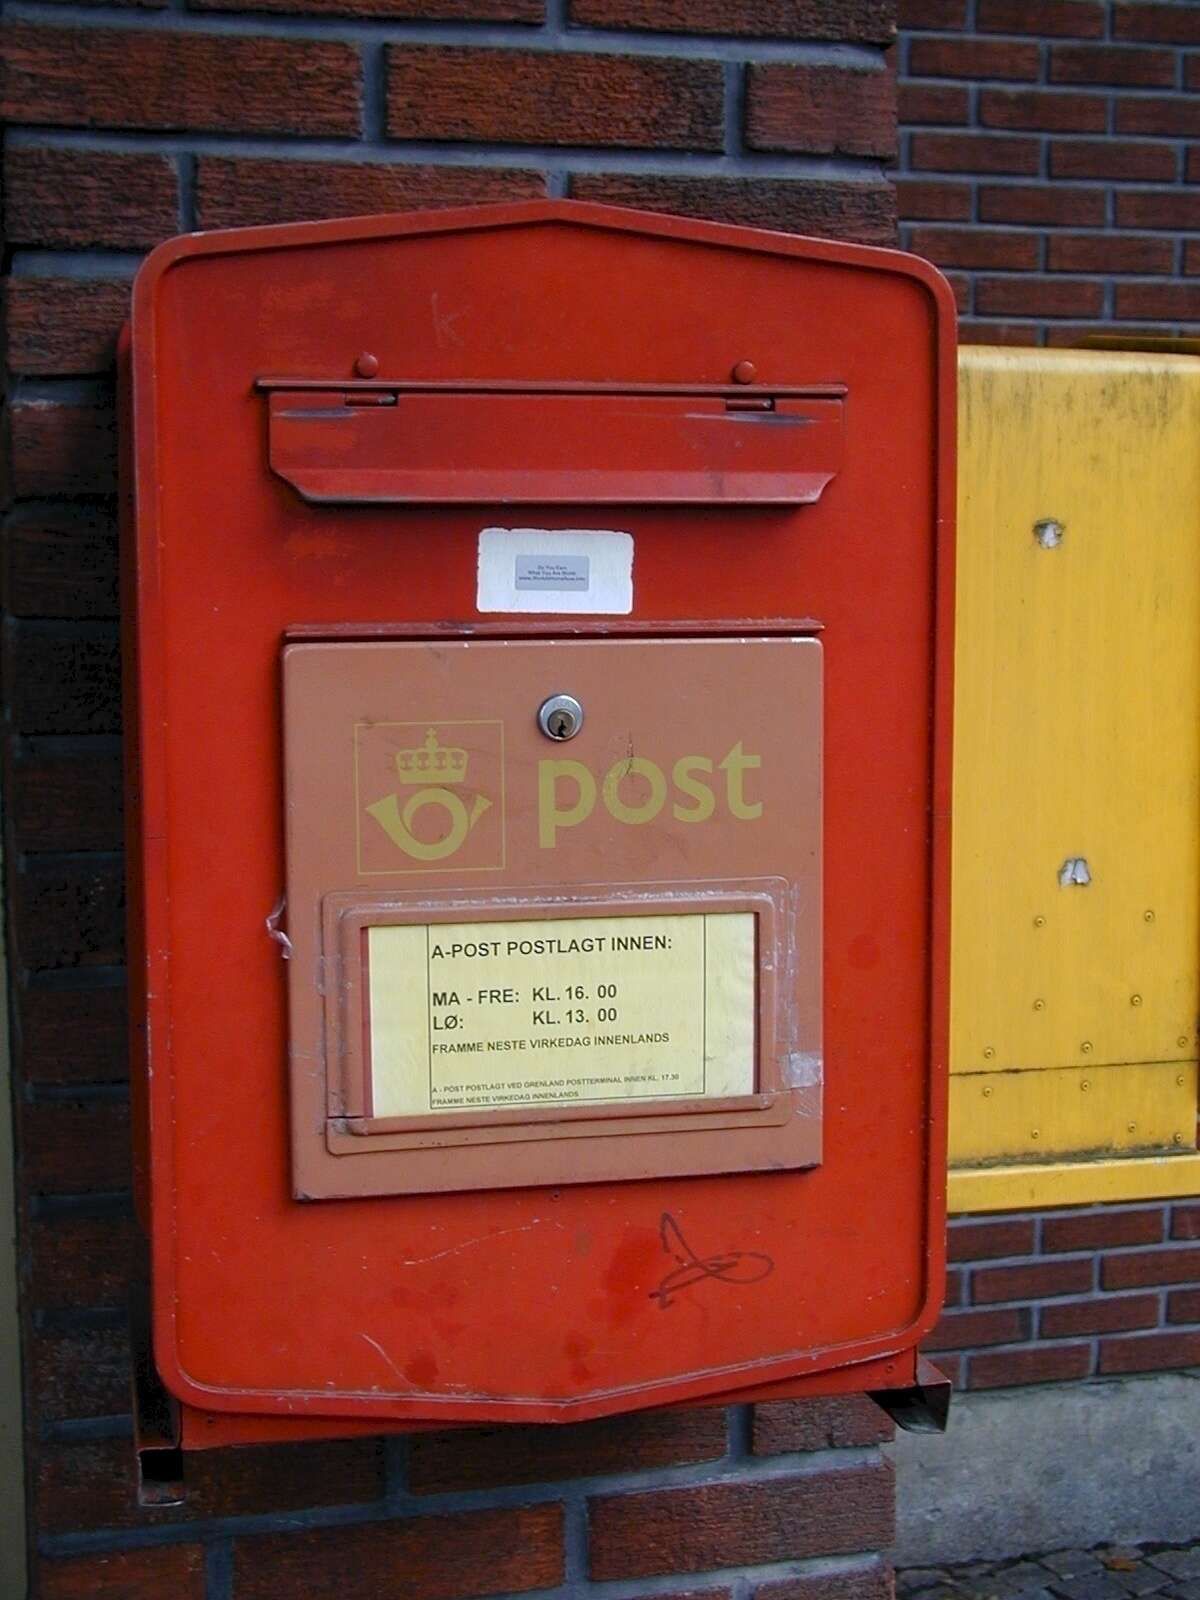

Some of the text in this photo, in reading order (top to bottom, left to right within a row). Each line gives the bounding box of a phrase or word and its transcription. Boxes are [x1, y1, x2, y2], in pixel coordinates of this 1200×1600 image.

[538, 740, 763, 849] post
[431, 936, 672, 959] A-POST POSTLAGT INNEN:
[432, 992, 461, 1007] MA
[478, 988, 520, 1005] FRE:
[532, 986, 561, 1001] KL.
[565, 985, 589, 1000] 16.
[597, 984, 618, 998] 00
[433, 1008, 618, 1030] LØ: KL. 13. 00
[432, 1033, 670, 1054] FRAMME NESTE VIRKEDAG INNENLANDS
[443, 1085, 465, 1093] POST
[465, 1083, 505, 1091] POSTLAGT
[506, 1081, 523, 1089] VED
[523, 1079, 565, 1088] GRENLAND
[566, 1076, 622, 1086] POSTTERMINAL
[624, 1075, 646, 1083] INNEN
[432, 1091, 580, 1105] FRAMME NESTE VIRKEDAG INNENLANDS
